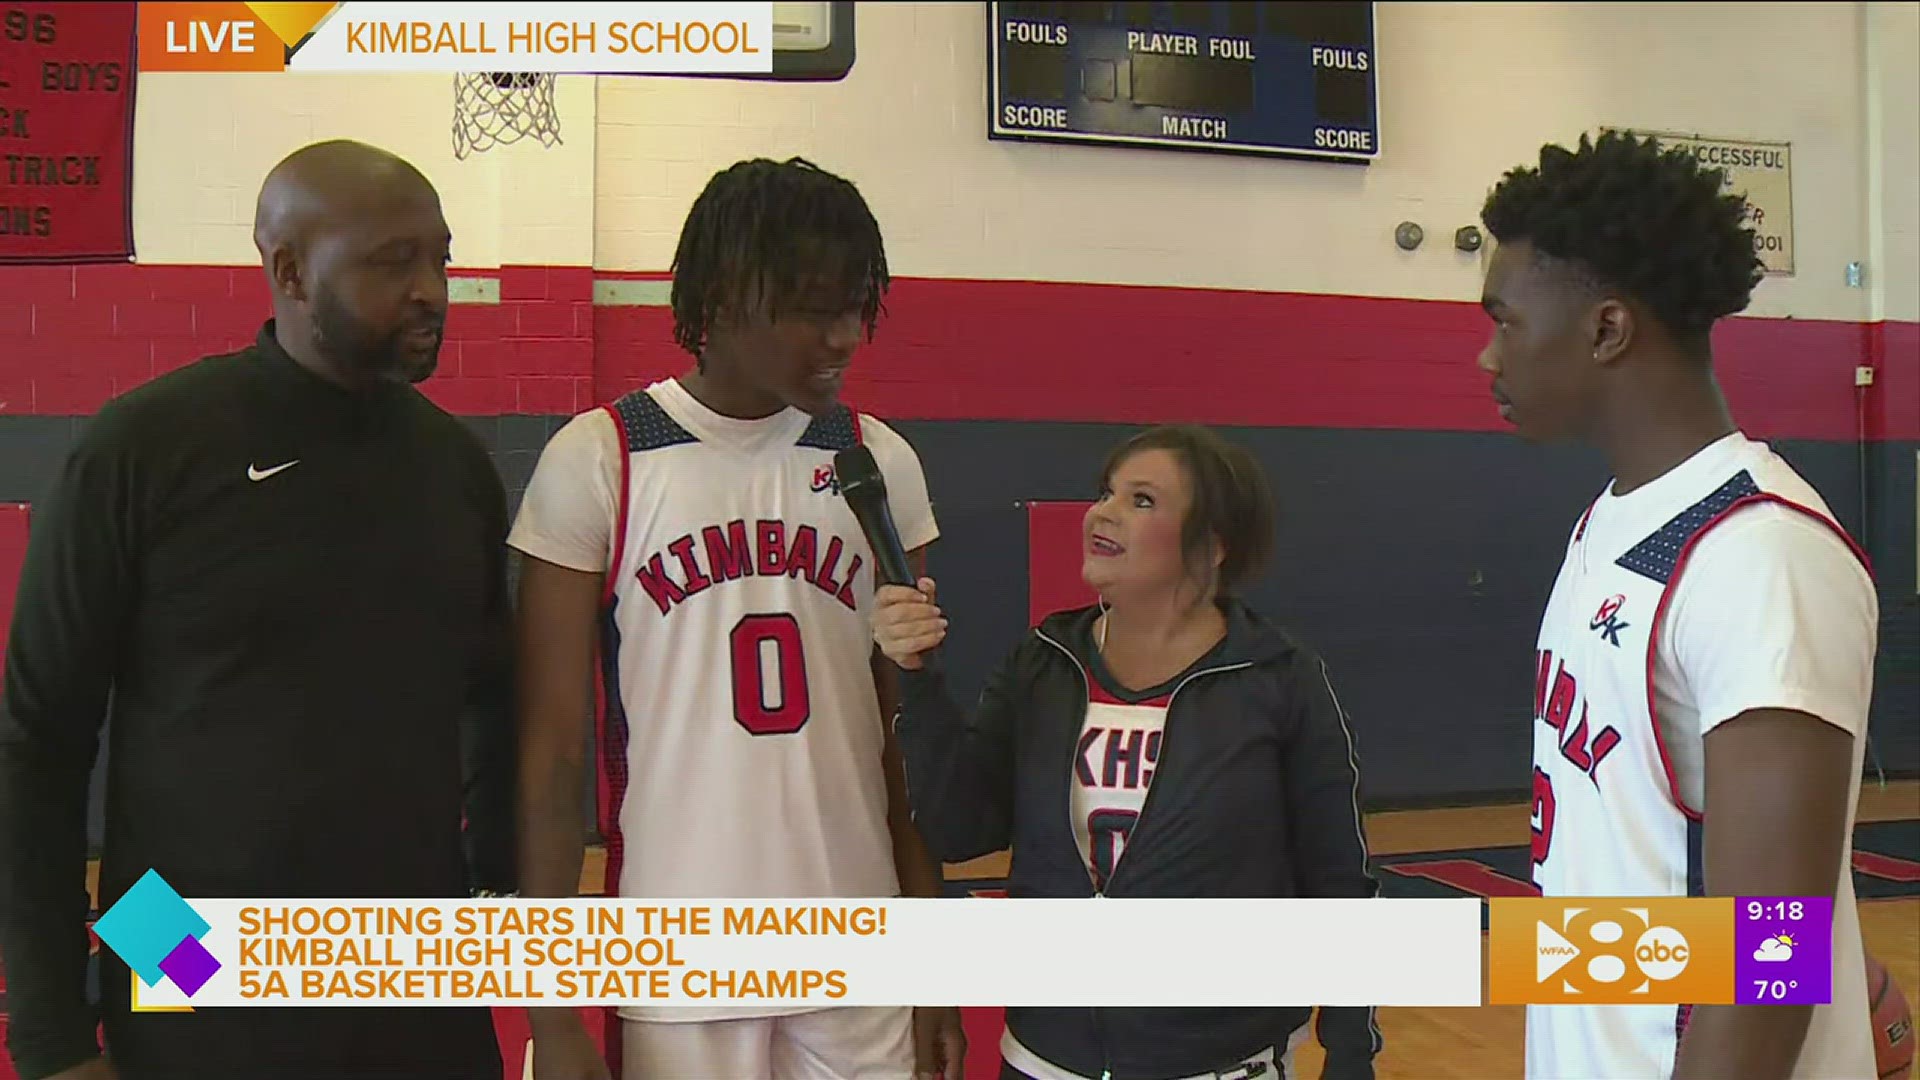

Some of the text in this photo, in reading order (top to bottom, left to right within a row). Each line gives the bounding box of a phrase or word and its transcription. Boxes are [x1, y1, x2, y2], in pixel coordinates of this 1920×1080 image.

[1004, 22, 1069, 46] FOULS
[1127, 31, 1256, 60] PLAYER FOUL
[1312, 47, 1369, 71] FOULS
[42, 61, 121, 92] BOYS
[1004, 105, 1068, 128] SCORE
[1162, 116, 1227, 139] MATCH
[1314, 128, 1372, 150] SCORE
[6, 153, 101, 186] TRACK
[635, 519, 863, 616] KIMBALL
[730, 612, 810, 736] 0
